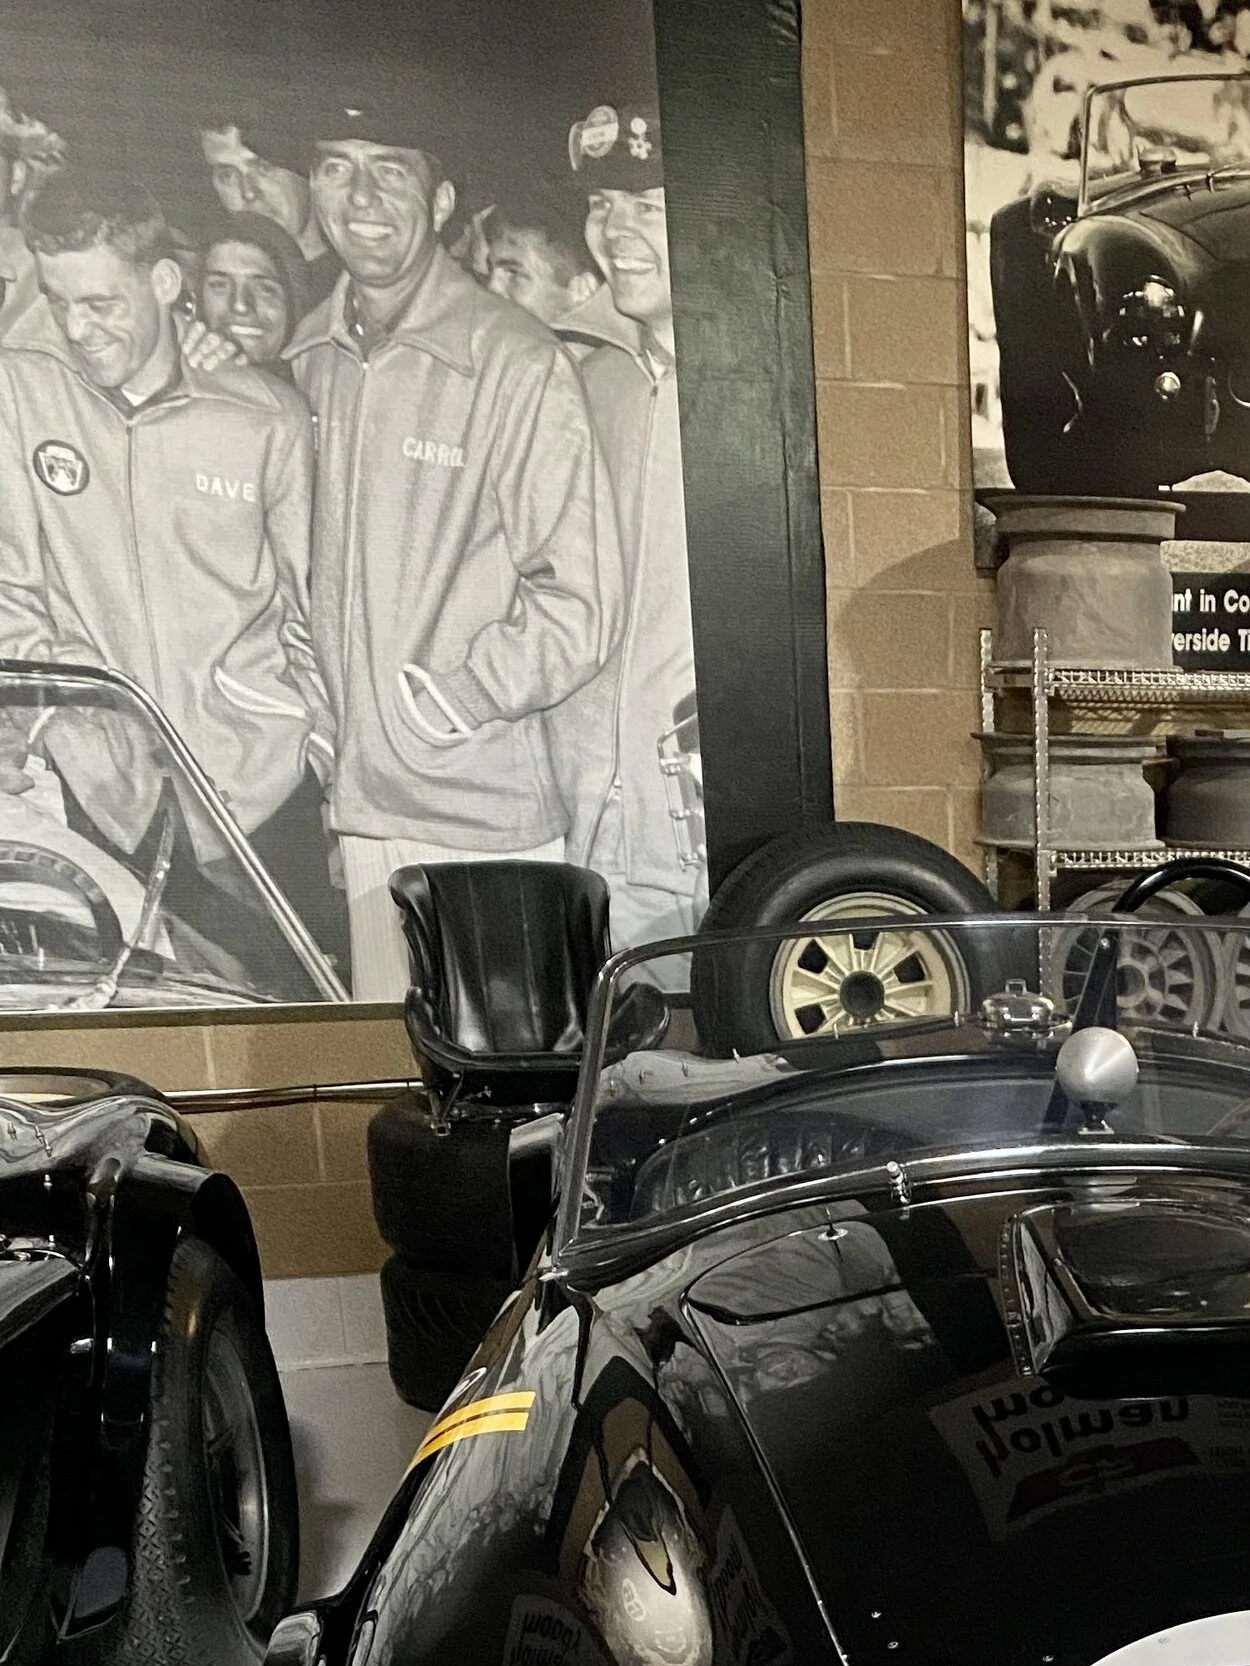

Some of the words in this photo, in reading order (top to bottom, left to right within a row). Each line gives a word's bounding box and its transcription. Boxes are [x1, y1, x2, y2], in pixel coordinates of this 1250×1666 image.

[195, 472, 256, 502] DAVE
[1172, 588, 1193, 613] nt
[1200, 588, 1217, 613] in
[1172, 627, 1231, 652] erside
